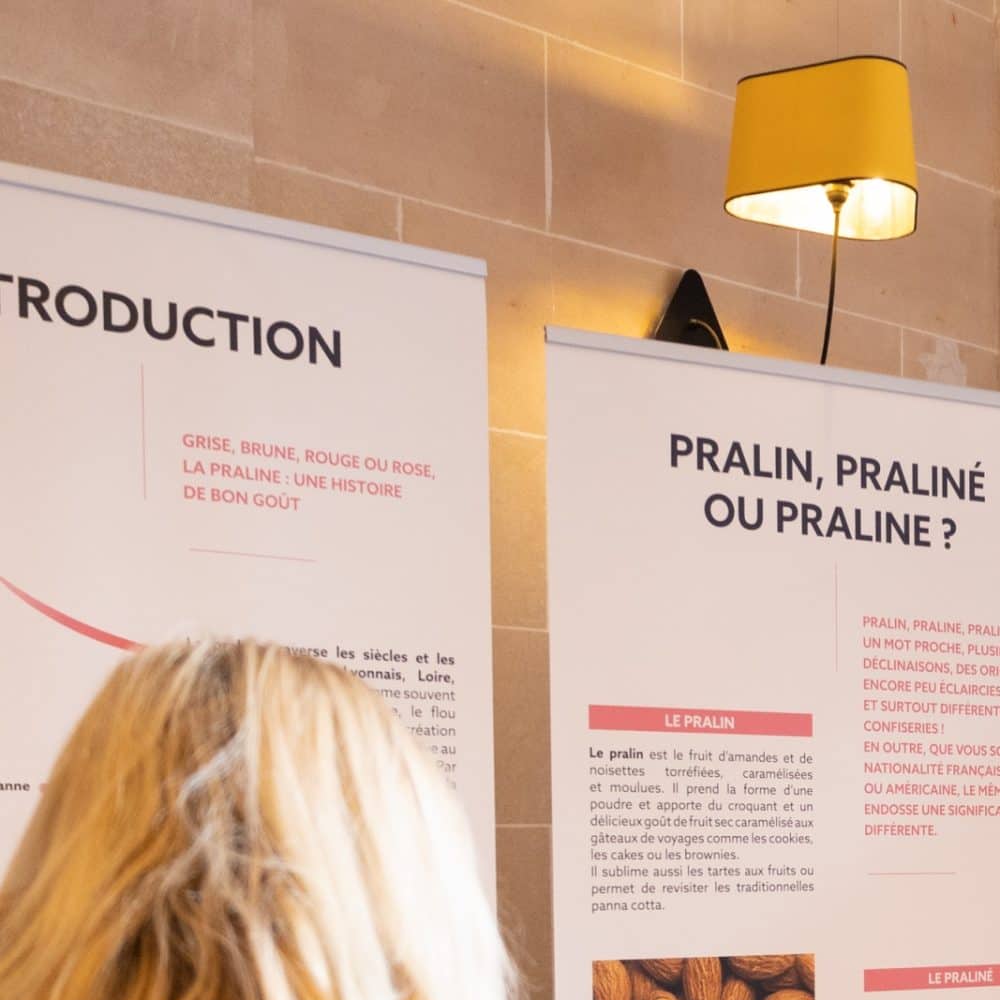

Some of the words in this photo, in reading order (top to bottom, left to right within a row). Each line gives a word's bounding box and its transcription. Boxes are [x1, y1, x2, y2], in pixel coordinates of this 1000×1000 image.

[0, 273, 342, 368] RODUCTION
[182, 433, 235, 454] GRISE,
[240, 440, 300, 463] BRUNE,
[304, 449, 360, 469] ROUGE
[364, 456, 388, 472] OU
[392, 460, 435, 480] ROSE,
[670, 433, 823, 490] PRALIN,
[836, 454, 985, 502] PRALINÉ
[182, 459, 206, 475] LA
[209, 462, 281, 484] PRALINE
[293, 472, 328, 489] UNE
[330, 477, 402, 498] HISTOIRE
[183, 484, 206, 501] DE
[210, 488, 248, 504] BON
[252, 492, 300, 511] GOÛT
[704, 493, 762, 530] OU
[777, 500, 930, 547] PRALINE
[862, 615, 910, 632] PRALIN,
[912, 619, 964, 636] PRALINE,
[336, 645, 355, 659] les
[362, 648, 408, 662] siècles
[415, 653, 429, 664] et
[436, 652, 455, 665] les
[863, 636, 880, 648] UN
[884, 638, 911, 651] MOT
[914, 640, 964, 656] PROCHE,
[863, 655, 952, 675] DÉCLINAISONS,
[956, 663, 978, 675] DES
[418, 669, 454, 684] Loire,
[402, 690, 456, 701] souvent
[411, 704, 422, 718] le
[431, 705, 455, 719] flou
[664, 714, 681, 727] LE
[683, 714, 735, 729] PRALIN
[588, 746, 604, 758] Le
[609, 747, 643, 761] pralin
[649, 750, 667, 760] est
[673, 749, 683, 760] le
[688, 748, 712, 761] fruit
[783, 754, 794, 763] et
[799, 752, 813, 764] de
[589, 764, 645, 776] noisettes
[664, 765, 723, 779] torréfiées,
[742, 767, 813, 780] caramélisées
[864, 821, 938, 836] DIFFÉRENTE.
[591, 848, 607, 860] les
[610, 848, 643, 860] cakes
[647, 851, 661, 860] ou
[665, 848, 681, 860] les
[684, 848, 739, 860] brownies.
[591, 902, 628, 913] panna
[630, 900, 664, 911] cotta.
[928, 972, 942, 984] LE
[944, 968, 993, 983] PRALINÉ
